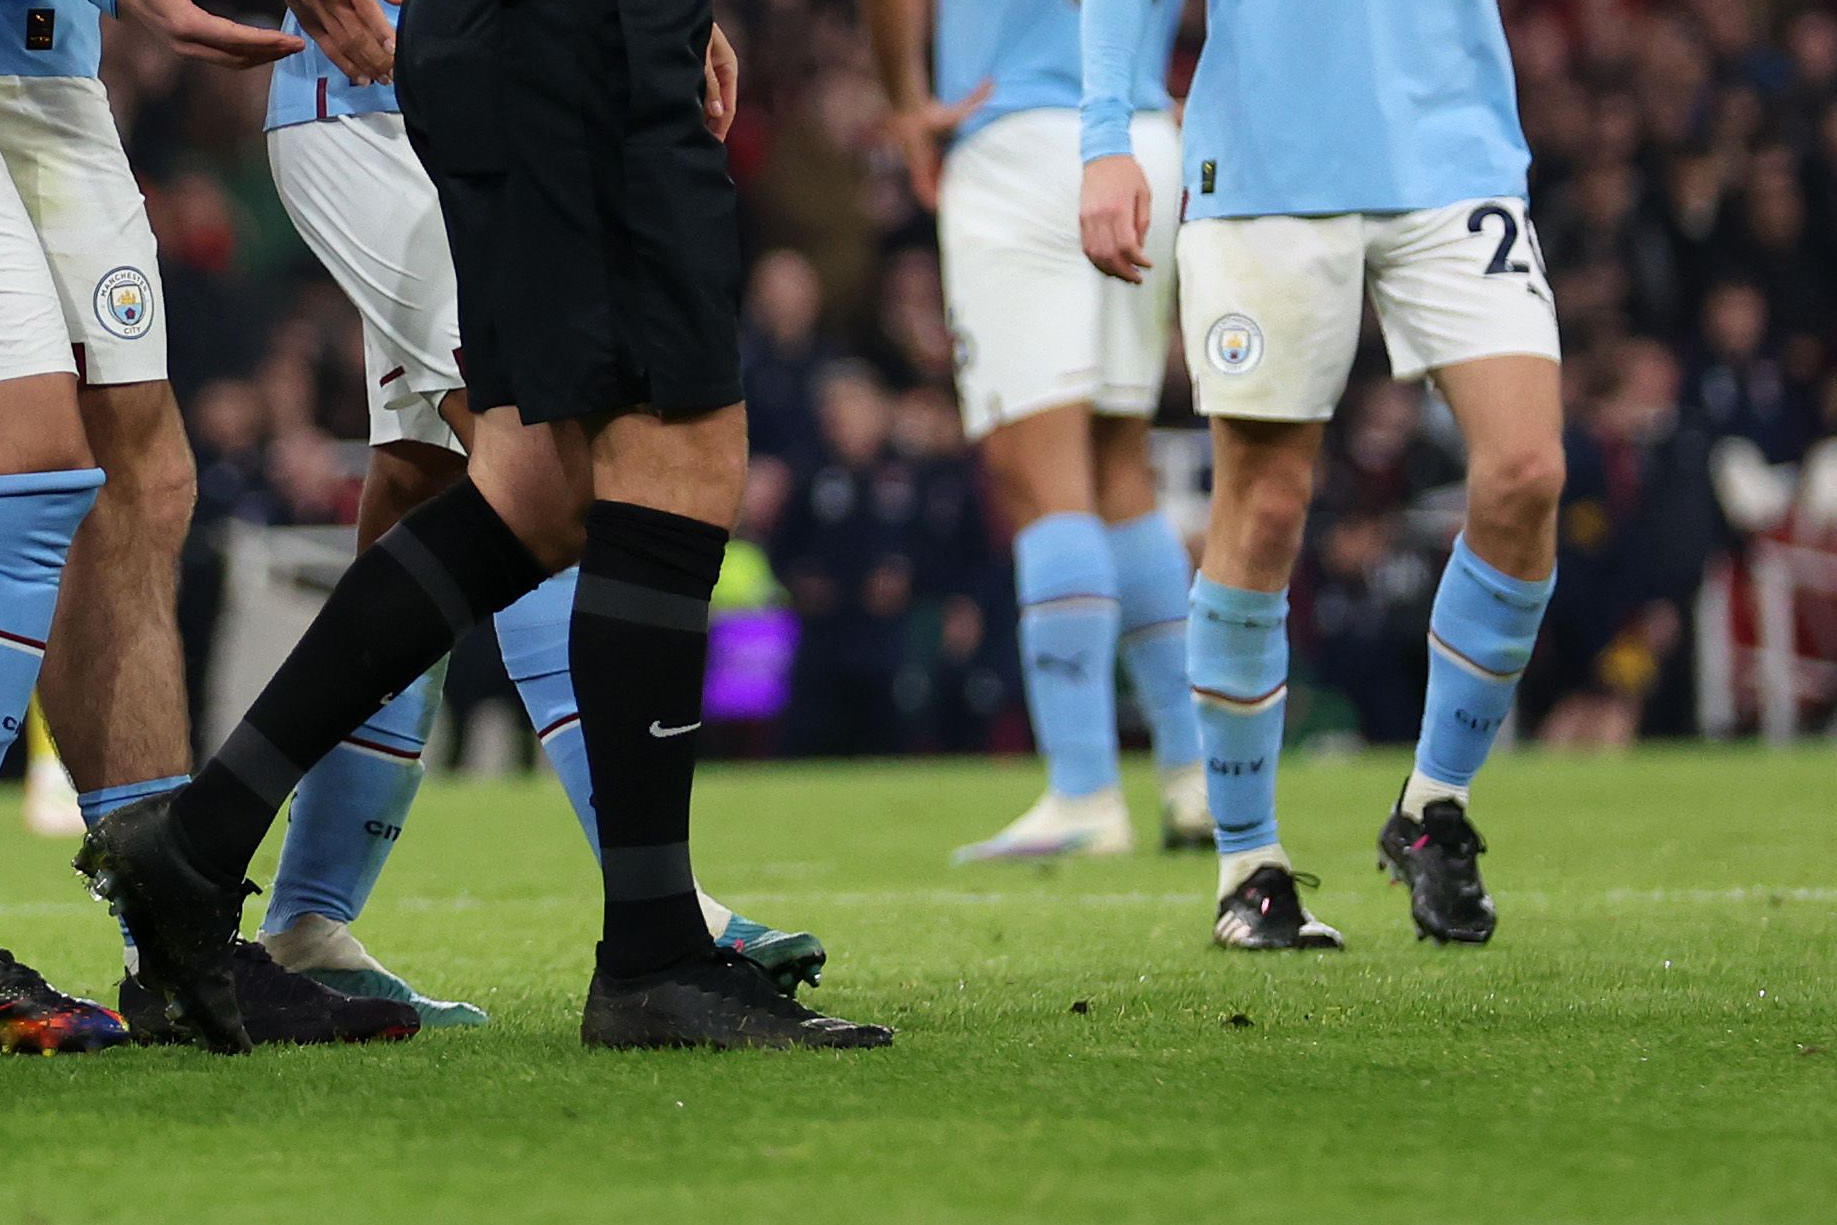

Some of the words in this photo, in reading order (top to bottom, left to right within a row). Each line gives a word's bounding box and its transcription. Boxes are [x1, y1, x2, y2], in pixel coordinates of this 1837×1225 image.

[100, 271, 147, 298] MANCHESTER
[123, 326, 141, 335] CITY
[364, 820, 402, 843] CIT
